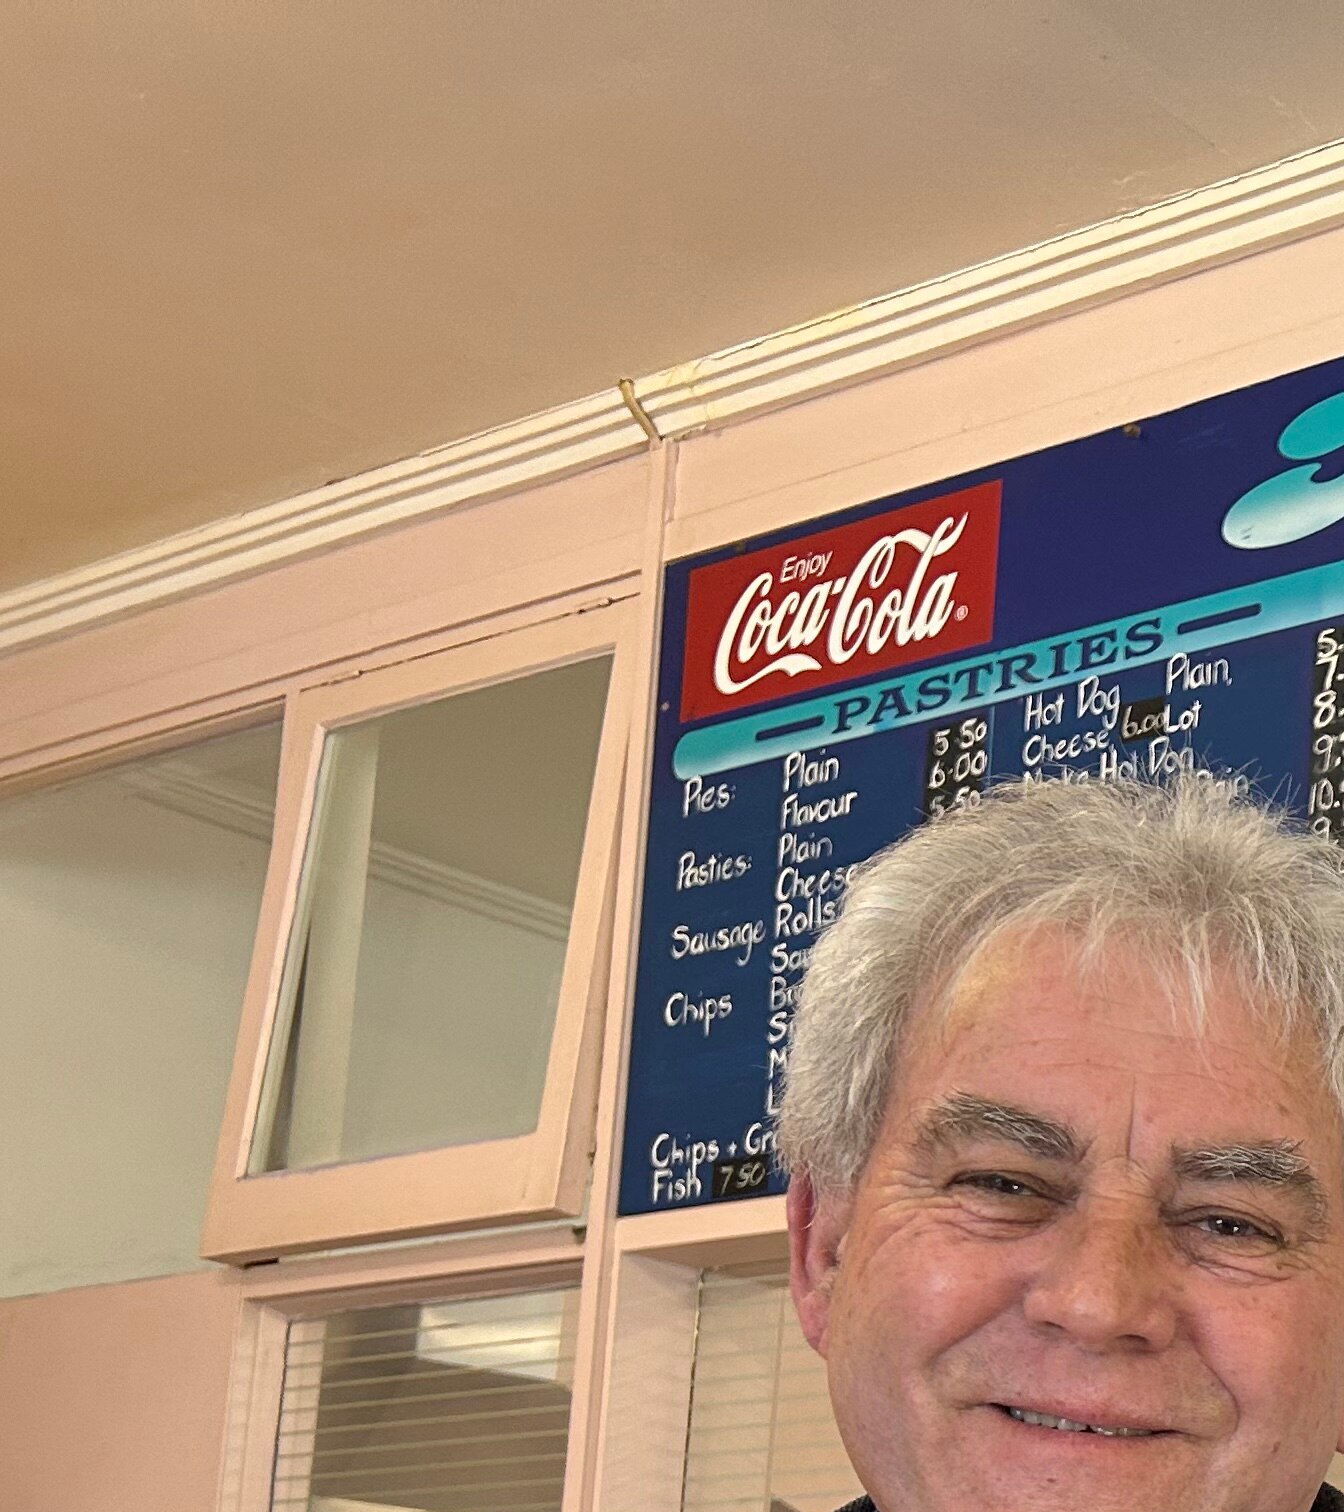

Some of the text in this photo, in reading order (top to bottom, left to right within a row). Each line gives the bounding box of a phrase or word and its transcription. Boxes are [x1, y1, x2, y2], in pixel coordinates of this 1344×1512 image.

[780, 550, 834, 583] Enjoy
[713, 511, 968, 695] Coca-Cola
[832, 617, 1164, 734] PASTRIES
[1023, 692, 1065, 732] Hot
[1076, 674, 1120, 731] Dog
[1163, 700, 1202, 733] Lot
[1021, 729, 1110, 767] Cheese
[782, 749, 840, 792] Plain
[927, 749, 988, 789] 6.00
[780, 791, 858, 831] Flavour
[777, 832, 833, 868] Plain
[670, 919, 766, 967] Sausage
[775, 894, 836, 939] Rolls
[665, 990, 733, 1037] Chips
[651, 1133, 720, 1179] Chips
[652, 1168, 702, 1205] Fish
